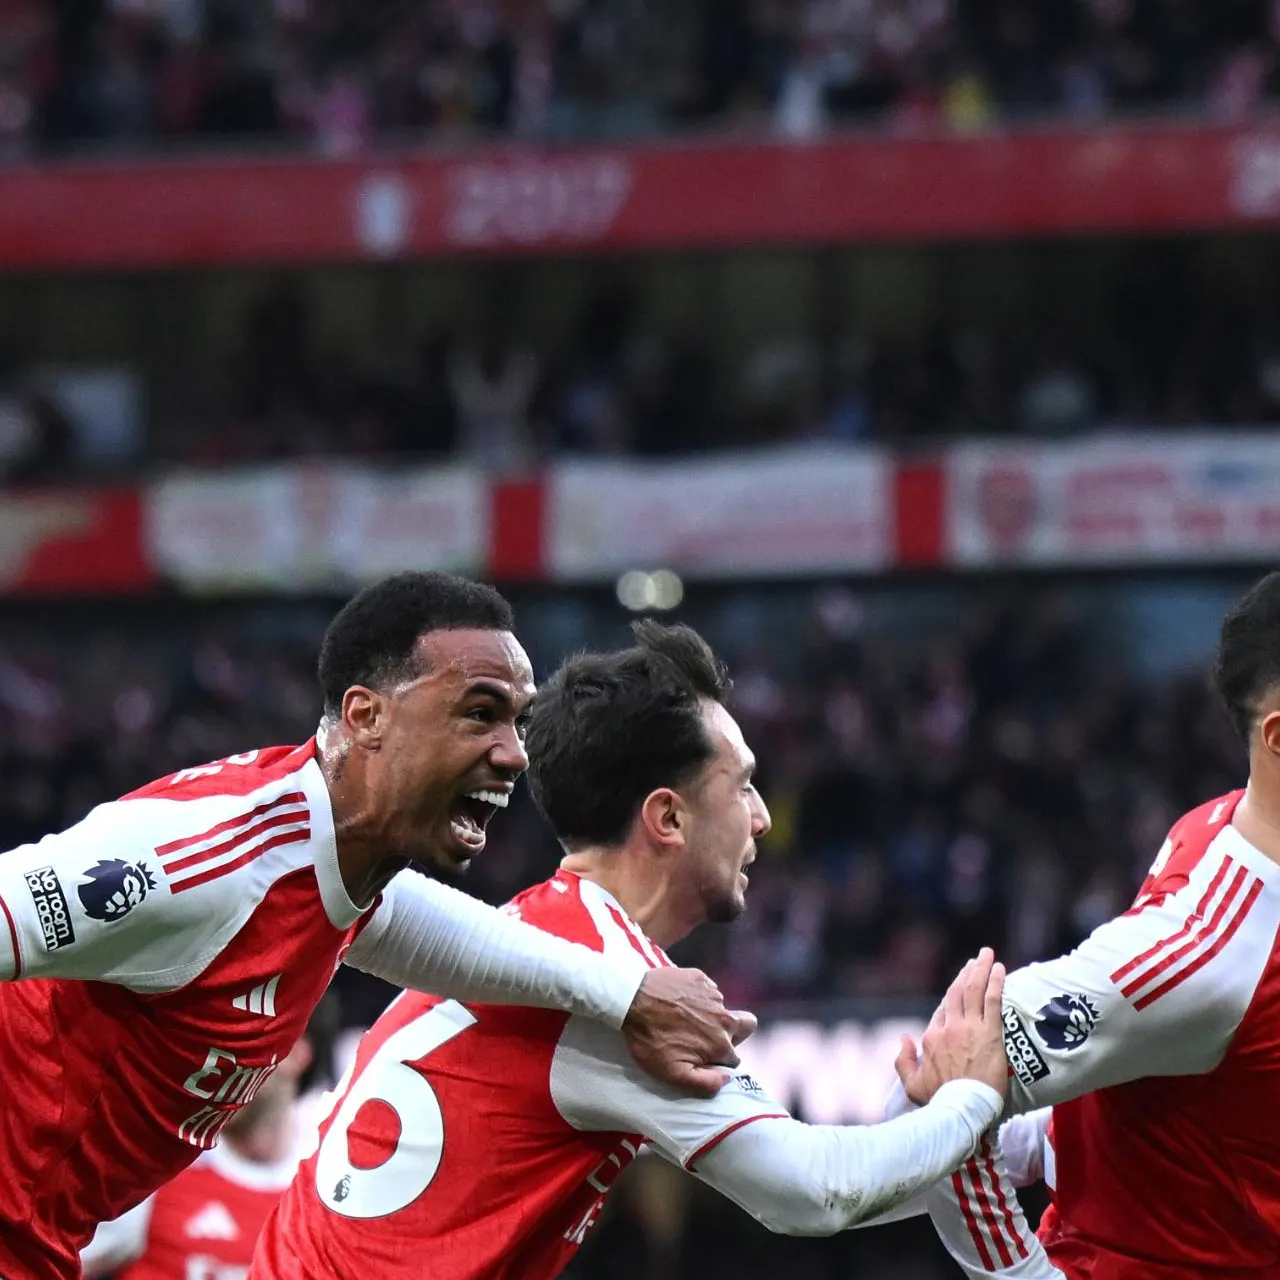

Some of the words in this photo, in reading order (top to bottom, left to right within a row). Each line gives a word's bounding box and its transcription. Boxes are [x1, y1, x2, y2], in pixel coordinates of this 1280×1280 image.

[24, 870, 45, 894] for
[39, 866, 57, 892] No
[34, 894, 59, 951] racism
[47, 891, 70, 939] room
[1003, 1006, 1019, 1032] No
[1012, 1030, 1043, 1074] room
[1005, 1037, 1035, 1087] racism
